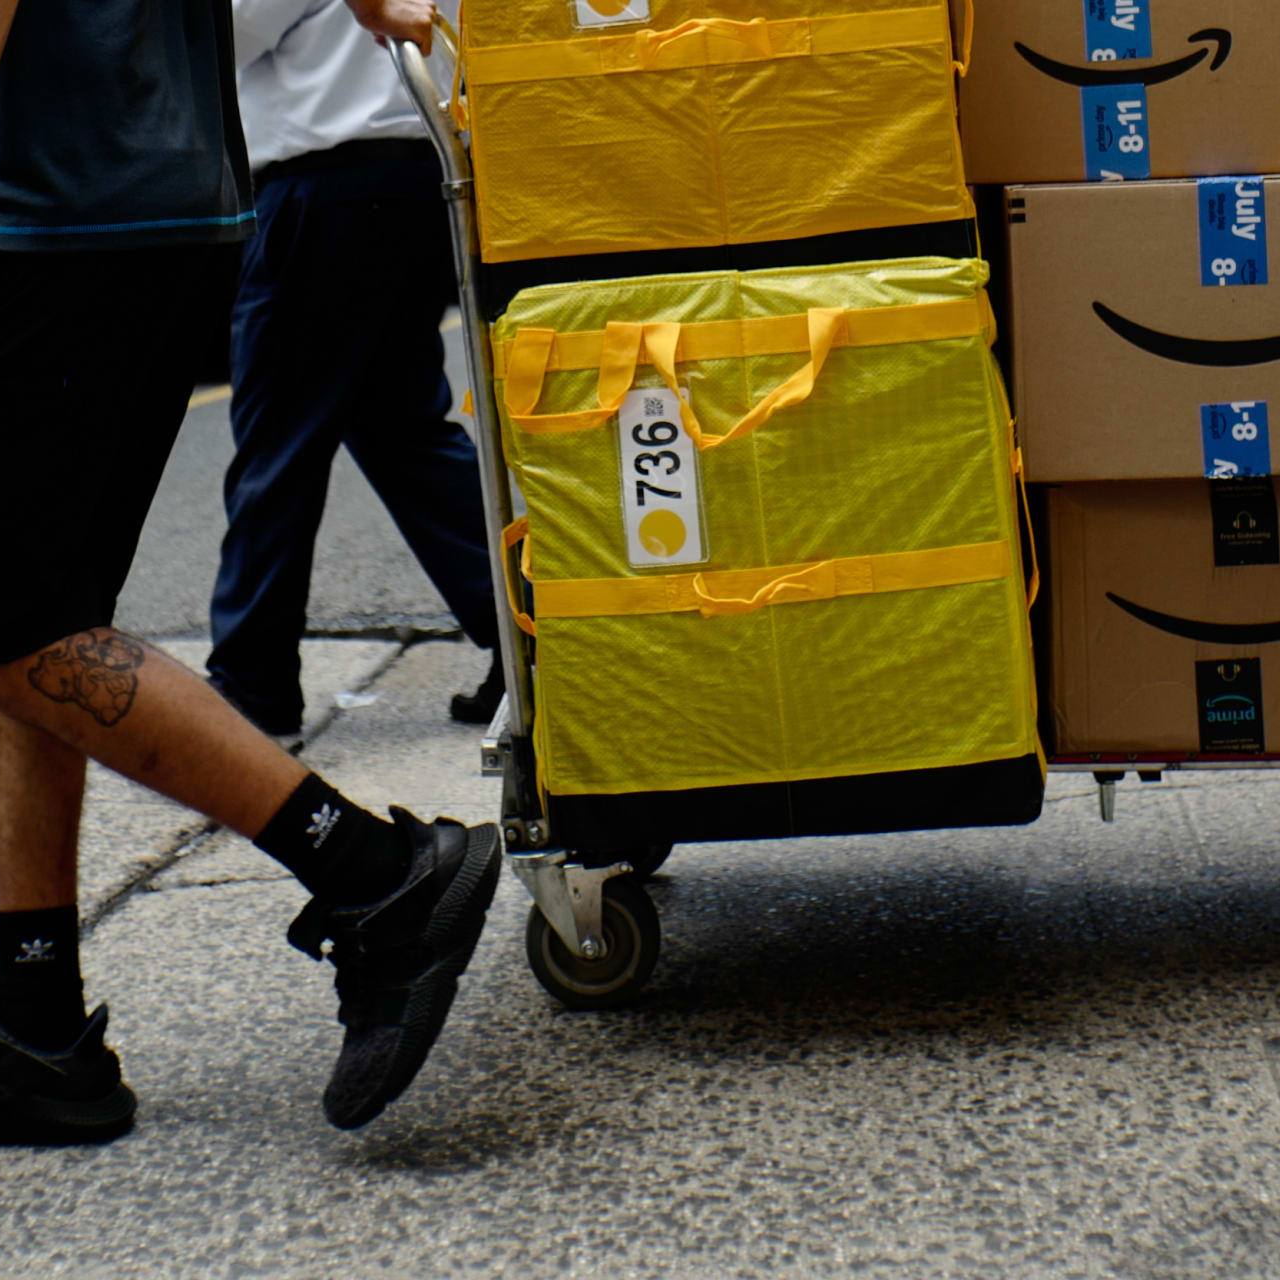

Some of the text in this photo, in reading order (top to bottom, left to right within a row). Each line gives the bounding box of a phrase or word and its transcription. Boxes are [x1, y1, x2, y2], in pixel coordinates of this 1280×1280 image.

[1116, 100, 1145, 153] 8-11
[1231, 181, 1262, 241] July
[632, 421, 682, 507] 736
[1207, 705, 1256, 726] prime
